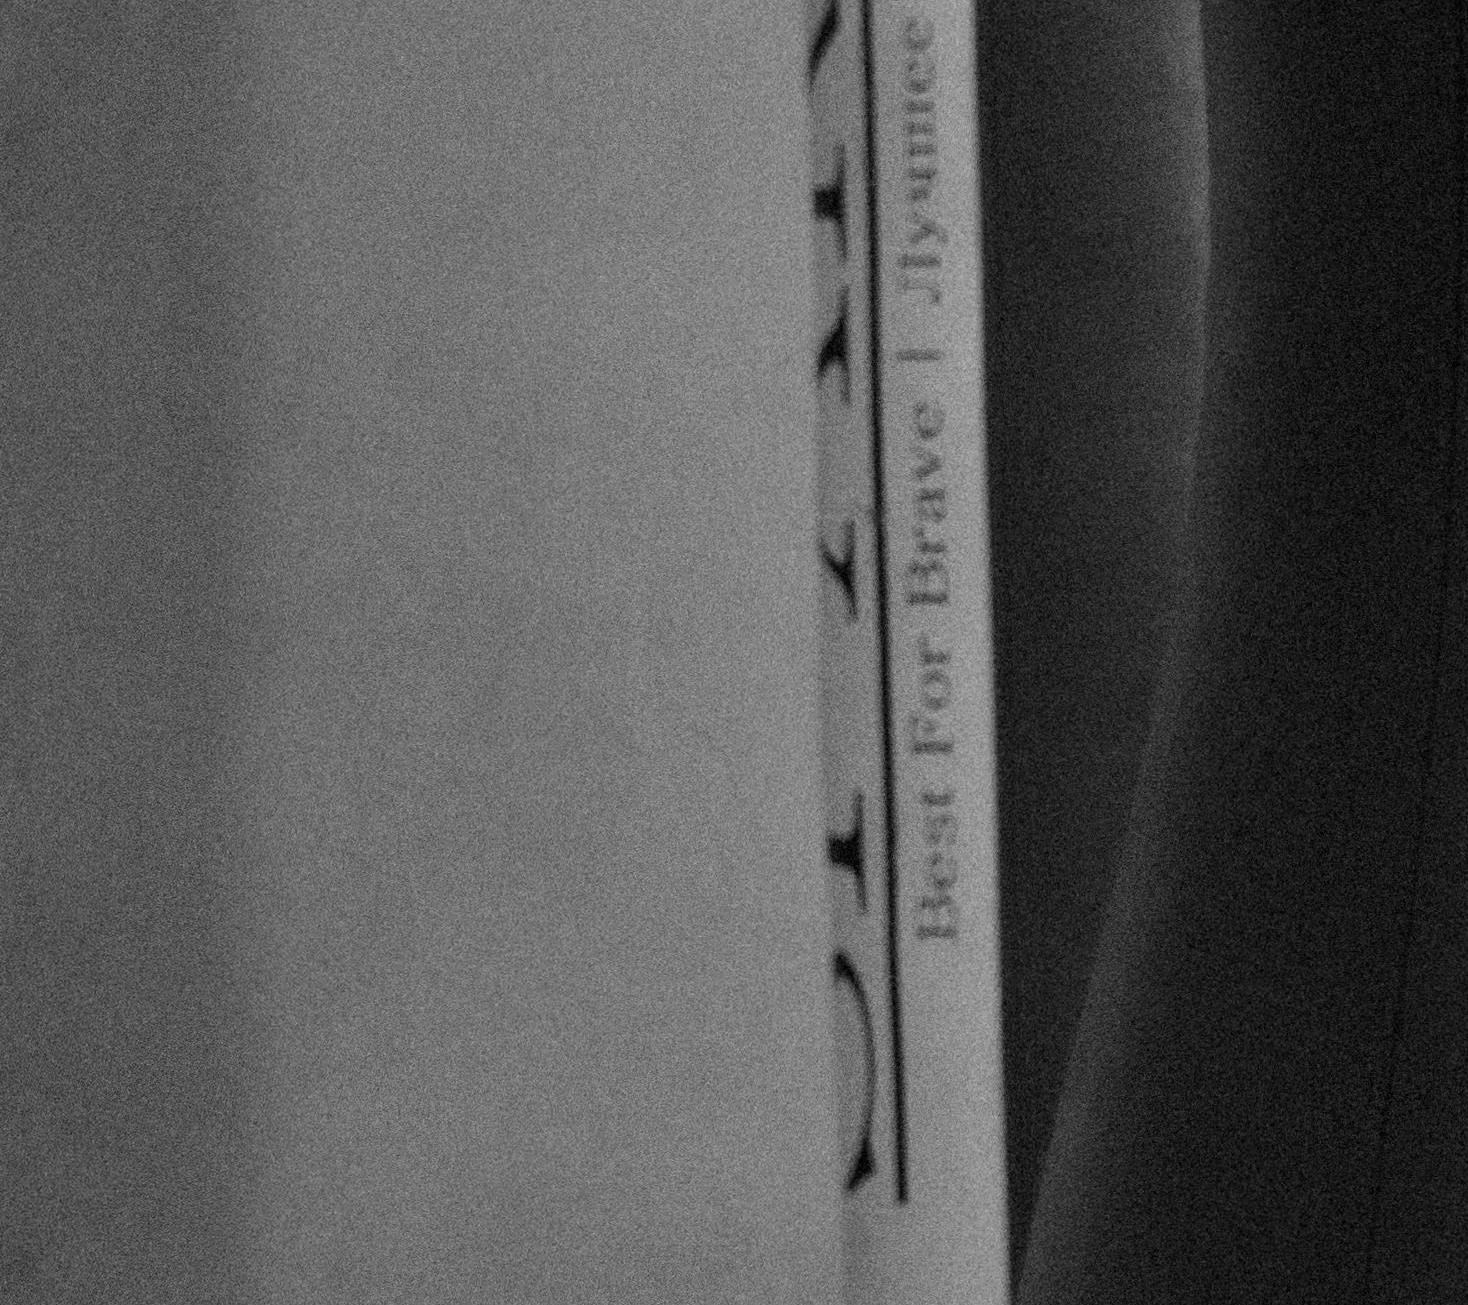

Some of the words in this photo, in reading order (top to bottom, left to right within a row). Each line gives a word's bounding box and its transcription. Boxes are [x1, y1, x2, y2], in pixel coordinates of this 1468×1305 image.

[895, 14, 948, 307] Лучшее
[906, 399, 952, 607] Brave
[909, 635, 955, 755] For
[915, 787, 960, 942] Best
